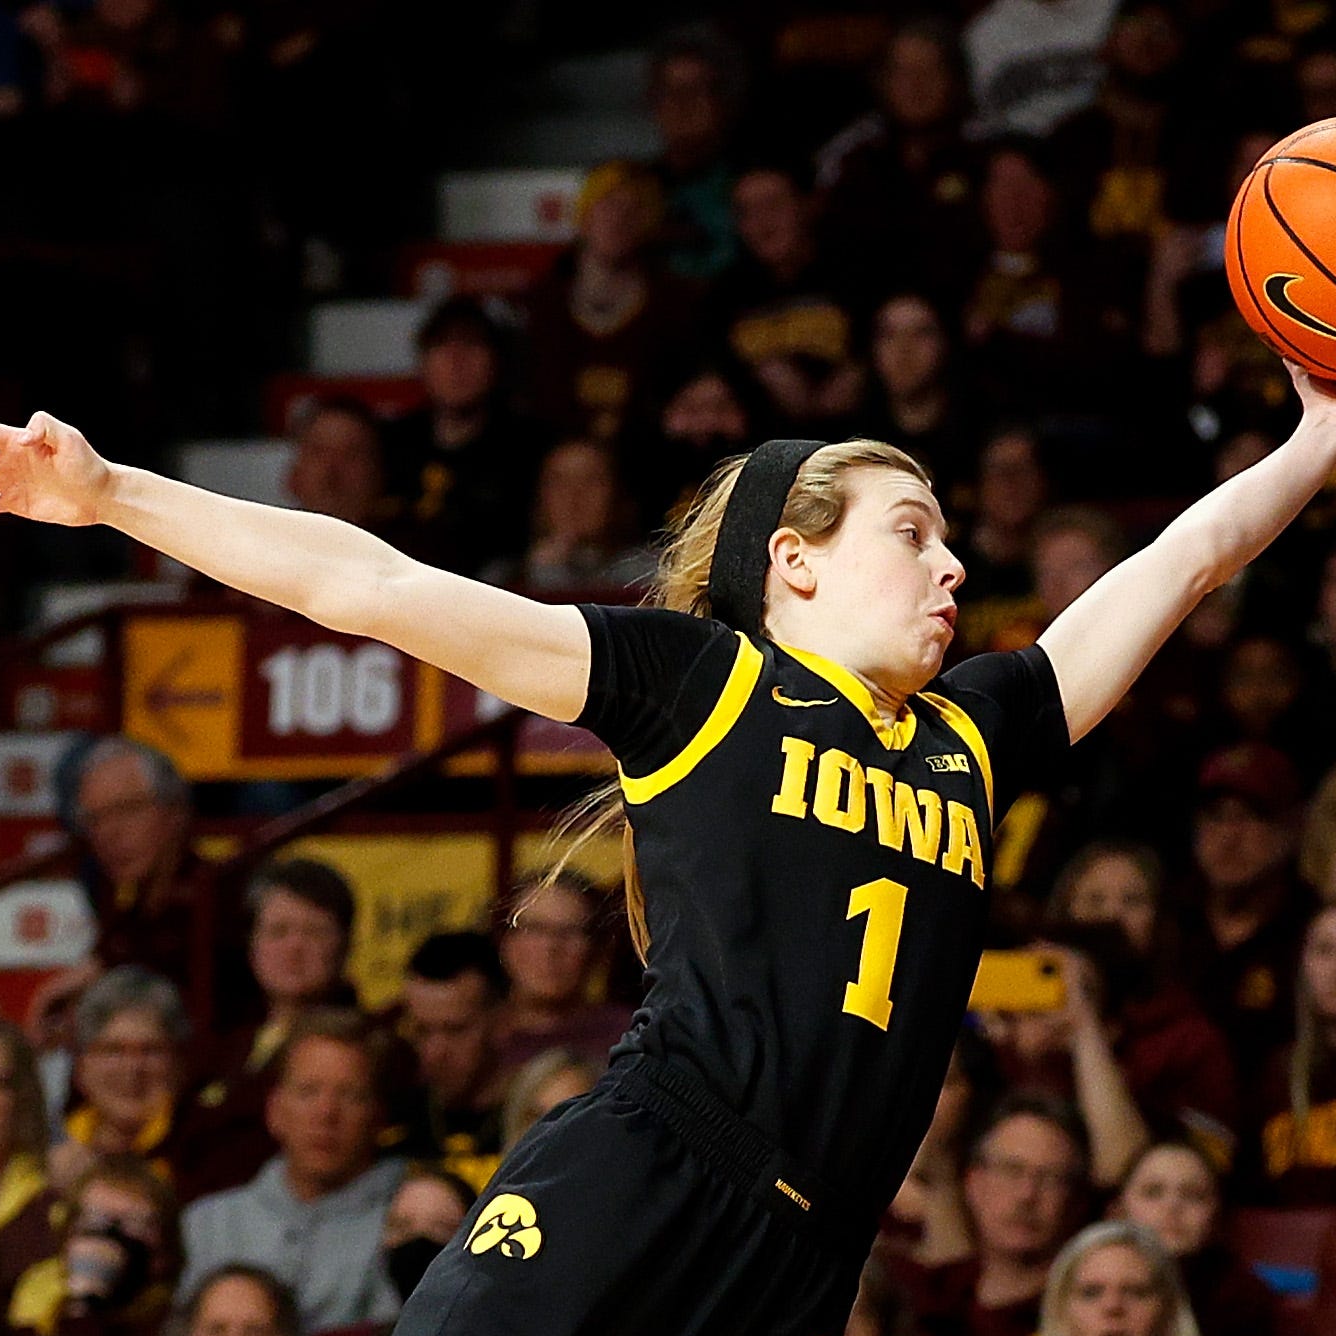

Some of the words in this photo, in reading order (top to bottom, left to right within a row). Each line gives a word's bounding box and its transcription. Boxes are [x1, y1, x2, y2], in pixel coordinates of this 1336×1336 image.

[260, 641, 403, 738] 106
[771, 735, 986, 891] IOWA
[841, 876, 909, 1032] 1
